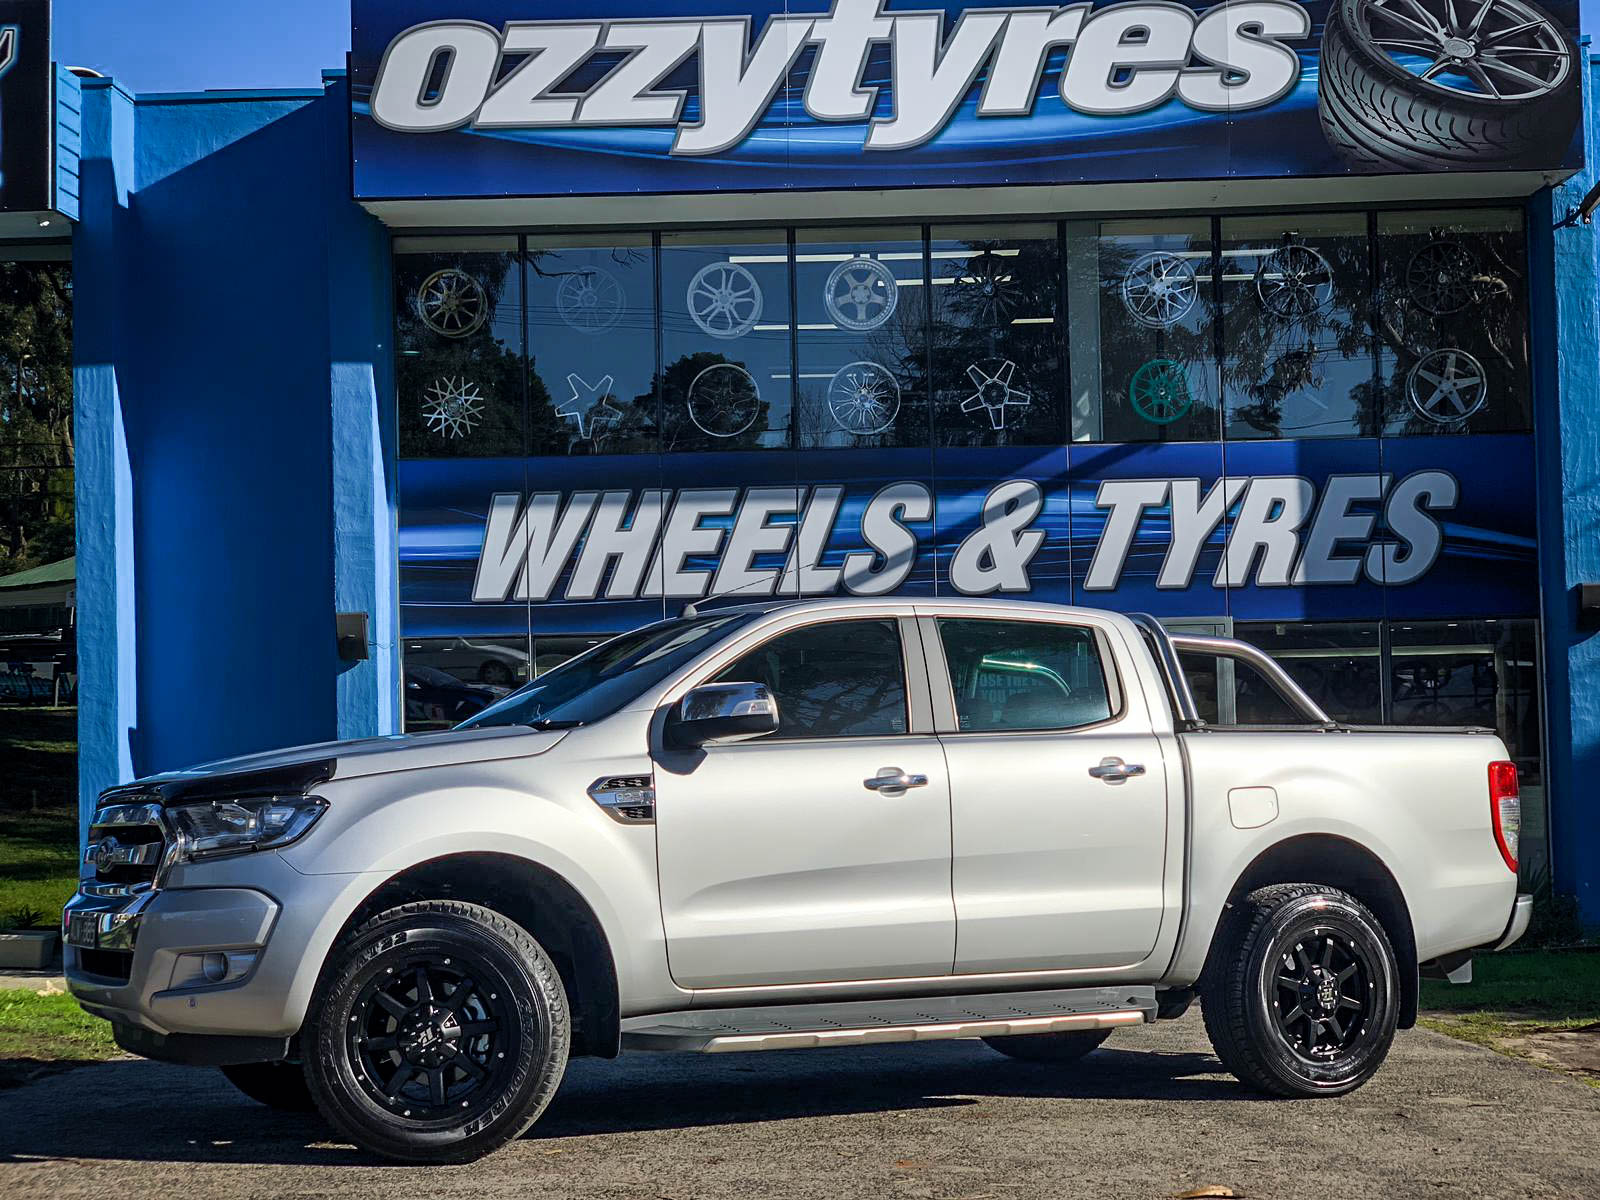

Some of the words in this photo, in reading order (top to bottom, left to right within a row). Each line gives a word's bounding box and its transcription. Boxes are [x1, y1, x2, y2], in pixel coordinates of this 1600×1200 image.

[370, 0, 1312, 155] ozzytyres
[471, 480, 933, 602] WHEELS
[949, 479, 1045, 595] &
[1082, 469, 1460, 591] TYRES
